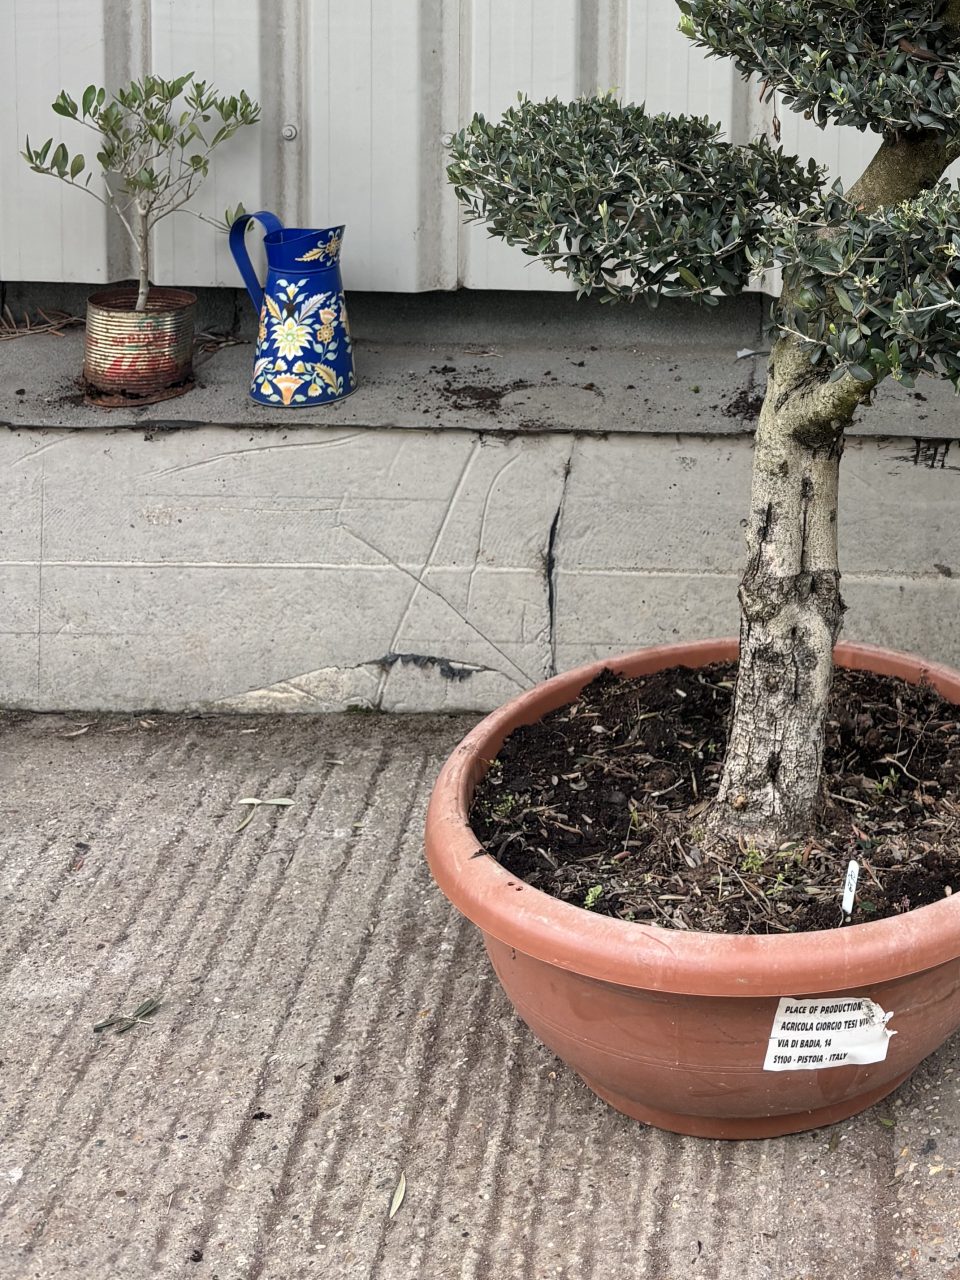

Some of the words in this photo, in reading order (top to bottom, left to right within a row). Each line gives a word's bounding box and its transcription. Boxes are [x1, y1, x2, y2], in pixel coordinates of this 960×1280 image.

[785, 1006, 807, 1014] PLACE
[809, 1006, 818, 1014] OF
[781, 1021, 814, 1031] AGRICOLA
[815, 1021, 842, 1031] GIORGIO
[843, 1019, 858, 1029] TESI
[777, 1039, 789, 1048] VIA
[791, 1039, 798, 1048] DI
[800, 1039, 822, 1049] BADIA,
[824, 1038, 832, 1047] 14
[773, 1054, 792, 1064] 51100
[797, 1055, 823, 1063] PISTOIA
[828, 1052, 848, 1062] ITALY
